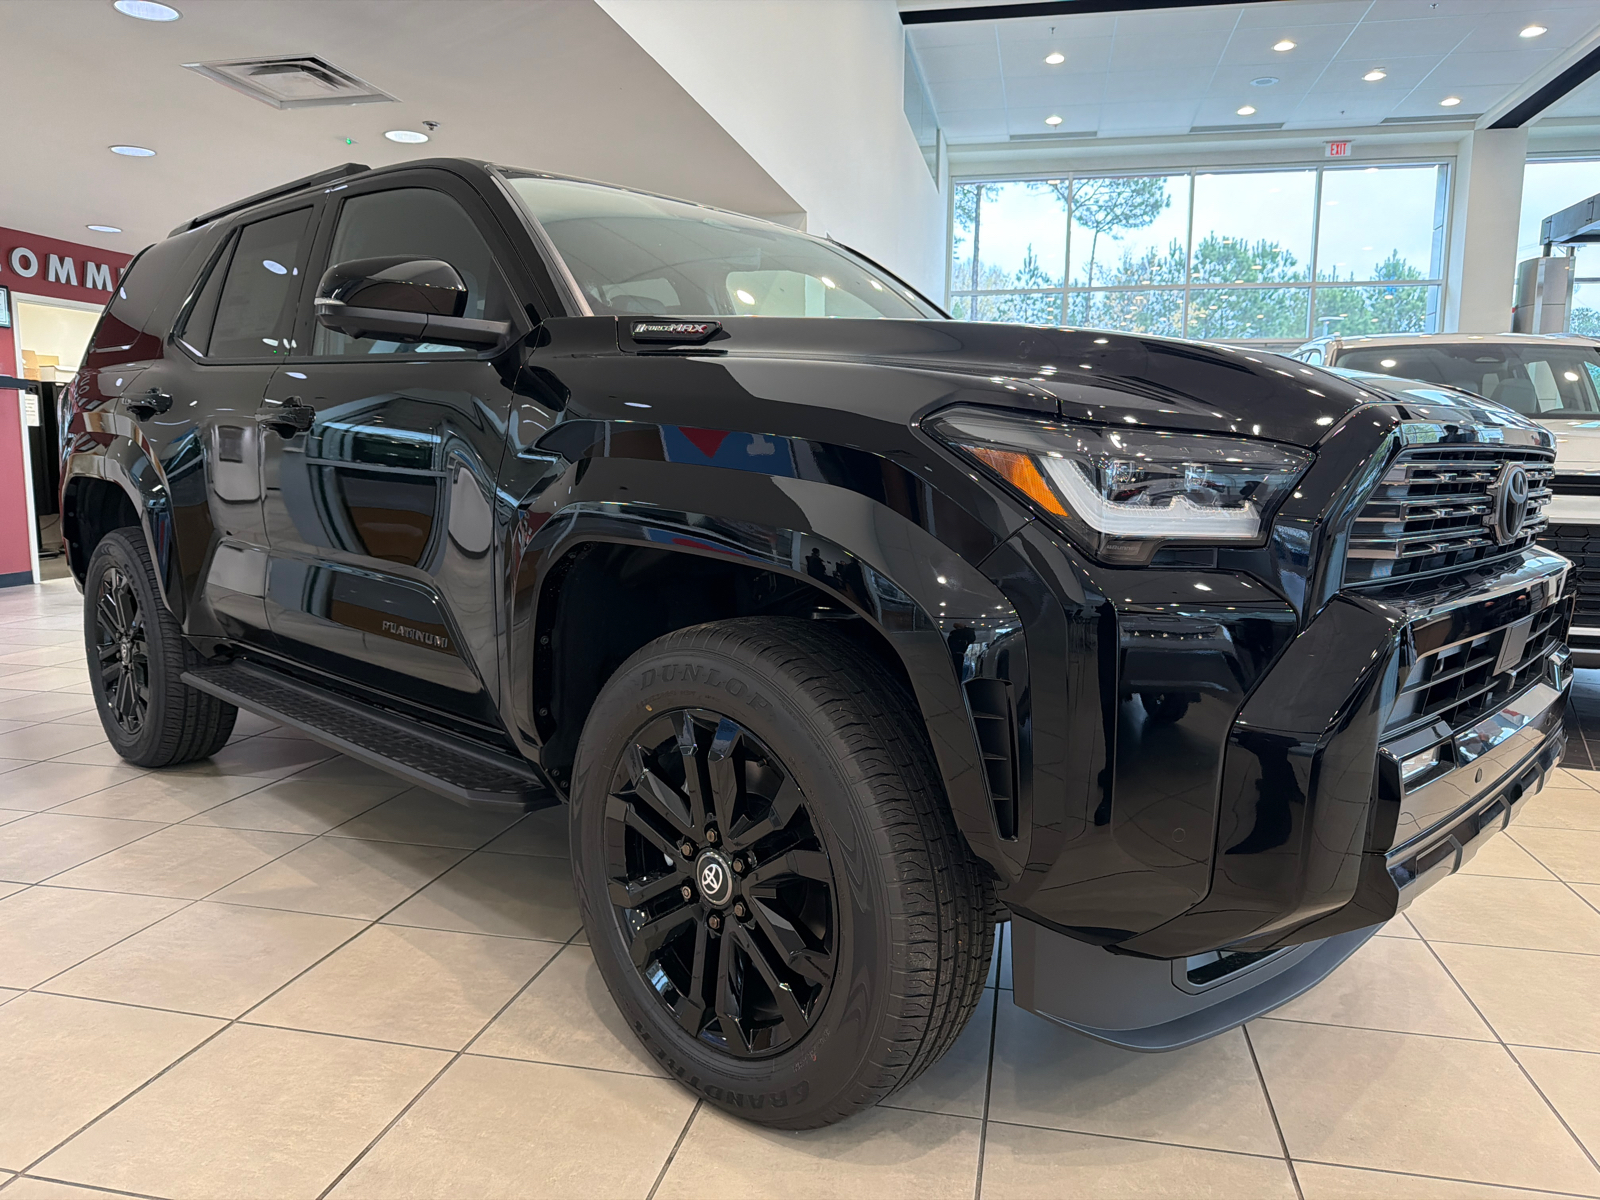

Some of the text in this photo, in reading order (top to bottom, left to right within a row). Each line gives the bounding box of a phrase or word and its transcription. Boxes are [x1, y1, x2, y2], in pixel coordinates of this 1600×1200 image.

[1330, 142, 1347, 156] EXIT
[0, 246, 125, 292] OMM
[382, 620, 448, 648] PLATINUM
[640, 663, 774, 711] DUNLOP
